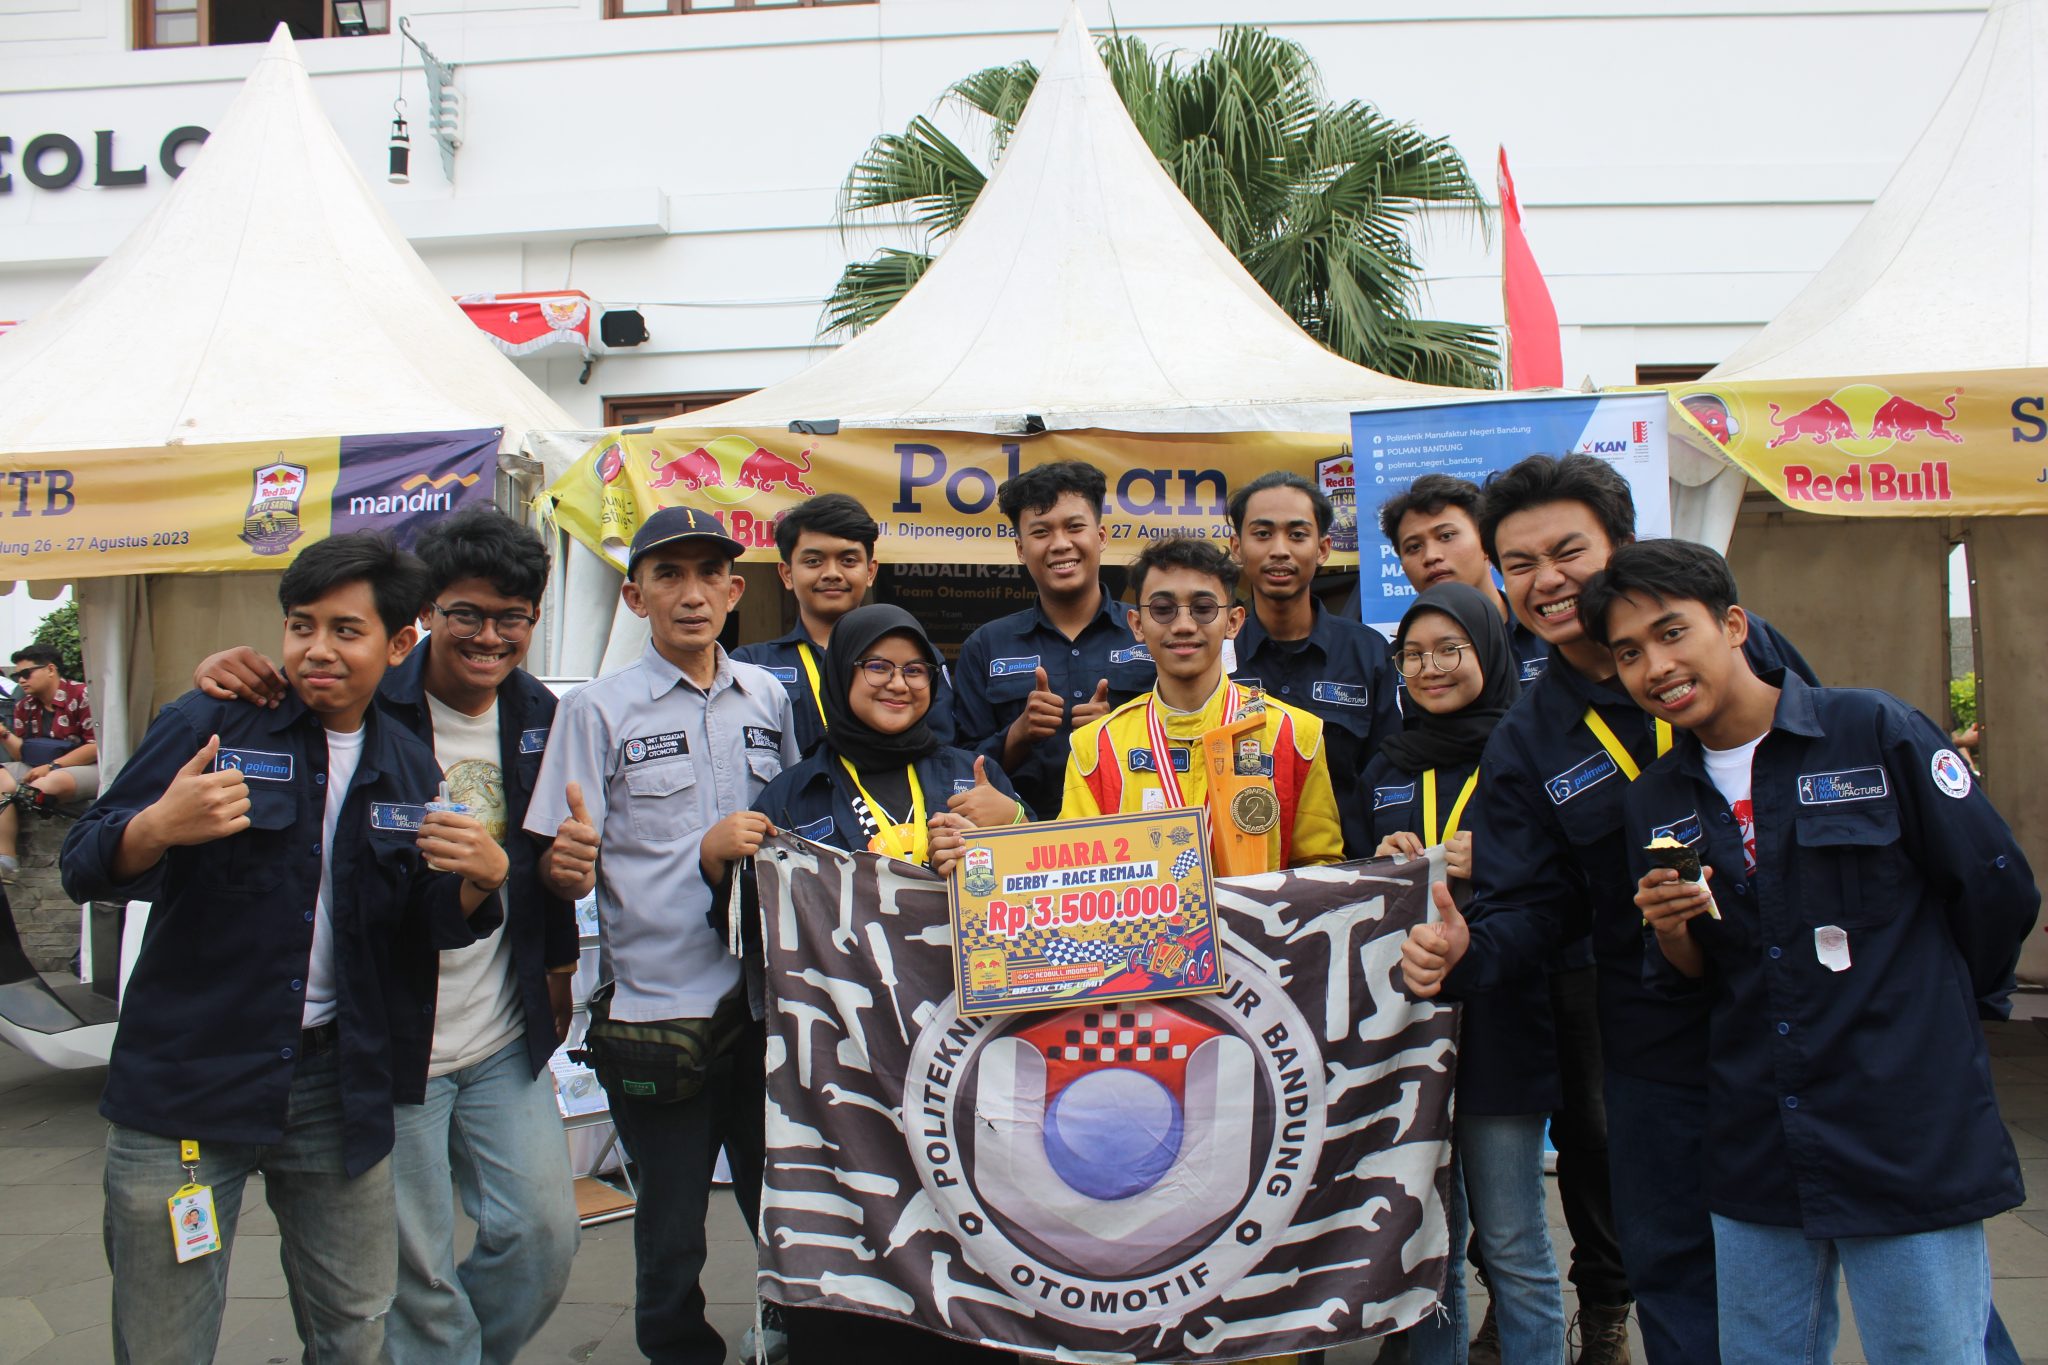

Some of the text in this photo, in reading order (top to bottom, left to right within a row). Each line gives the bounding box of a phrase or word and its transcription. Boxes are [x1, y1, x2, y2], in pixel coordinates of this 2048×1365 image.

[0, 126, 212, 194] OLO
[1386, 425, 1531, 442] Politeknik Manufaktur Negeri Bandung
[1387, 444, 1463, 456] POLMAN BANDUNG
[1594, 441, 1627, 453] KAN
[892, 444, 1229, 515] Polan
[1783, 461, 1953, 503] Red Bull
[262, 486, 297, 497] Red Bull
[350, 488, 451, 515] mandiri
[898, 523, 992, 541] Diponegoro
[1112, 525, 1132, 538] 27
[1137, 524, 1206, 541] Agustus
[1211, 524, 1232, 539] 20
[0, 539, 29, 556] ung
[34, 539, 52, 553] 26
[66, 537, 85, 551] 27
[88, 535, 148, 553] Agustus
[152, 531, 190, 546] 2023
[893, 585, 1039, 600] Team Otomotif Polm
[1008, 661, 1038, 673] polman
[645, 733, 685, 745] UNIT KEGIATAN
[647, 740, 679, 751] MAHASISWA
[245, 762, 289, 774] polman
[1575, 759, 1610, 788] polman
[1818, 776, 1840, 785] HALF
[1818, 782, 1854, 793] NORMAL
[1819, 785, 1883, 799] MANUFACTURE
[1245, 796, 1266, 822] 2
[1025, 837, 1131, 871] JUARA 2
[1006, 874, 1049, 892] DERBY
[1062, 867, 1097, 886] RACE
[1100, 863, 1153, 882] REMAJA
[988, 884, 1178, 937] Rp 3.500.000
[1011, 979, 1105, 995] BREAK THE LIMIT
[924, 1014, 992, 1188] POLITEKNI
[1261, 1021, 1309, 1198] BANDUNG
[1010, 1262, 1213, 1314] OTOMOTIF
